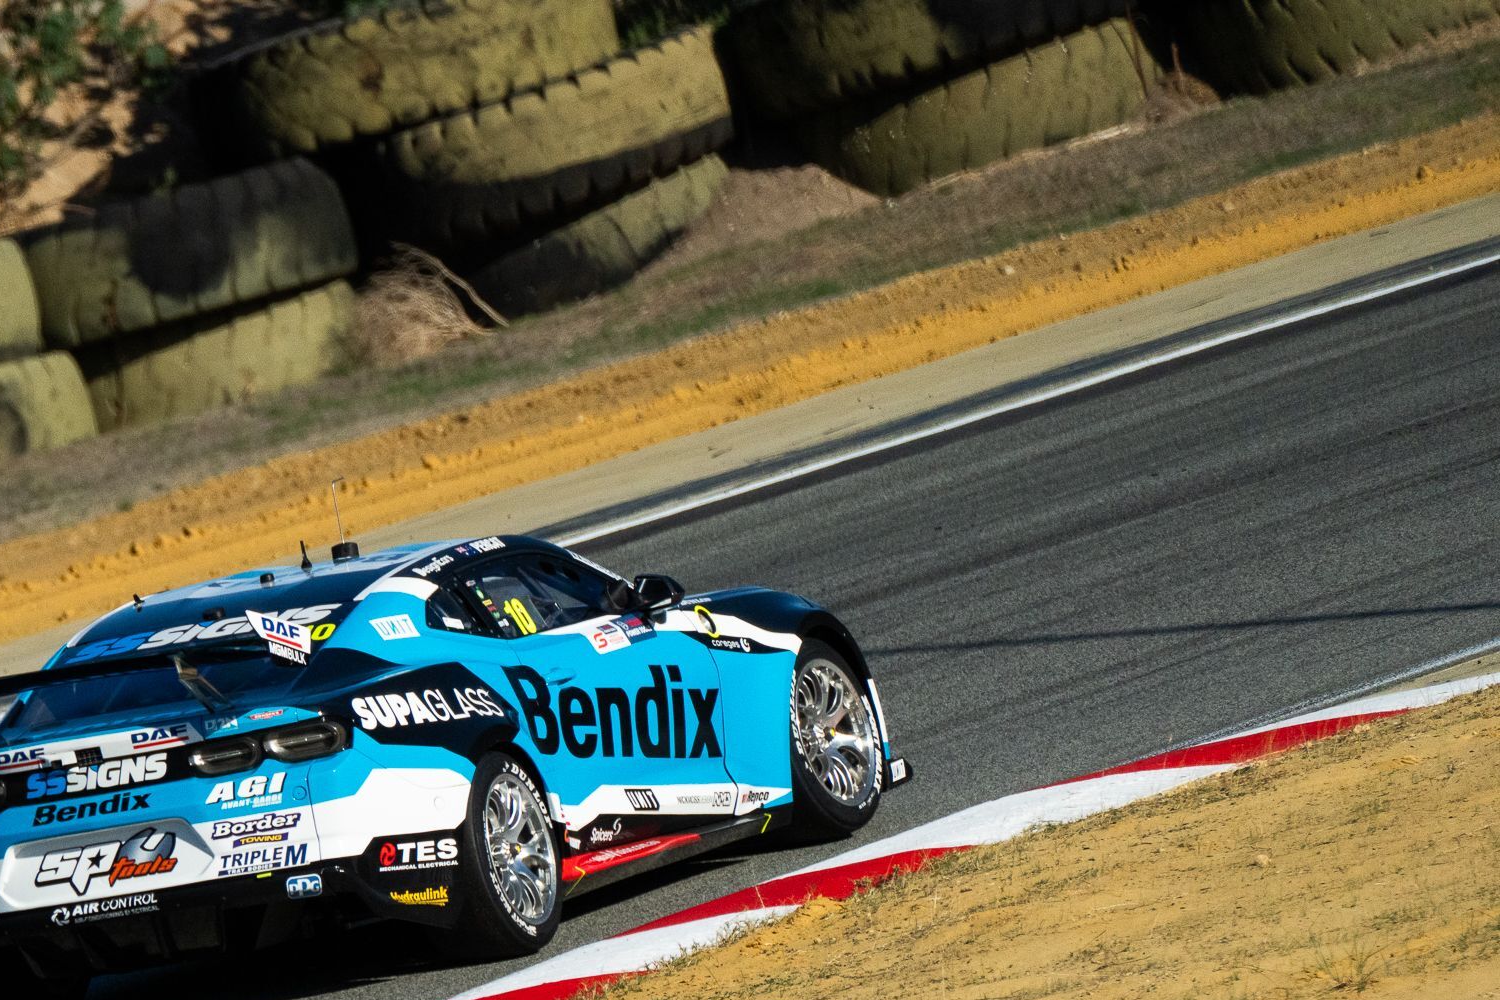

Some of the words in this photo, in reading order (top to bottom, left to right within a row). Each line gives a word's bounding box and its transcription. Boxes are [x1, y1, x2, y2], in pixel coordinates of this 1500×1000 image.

[261, 616, 300, 639] DAF
[503, 597, 537, 636] 10
[307, 623, 336, 641] 0
[351, 687, 504, 731] SUPAGLASS
[500, 664, 724, 759] Bendix
[131, 724, 188, 745] DAF
[205, 771, 286, 805] AGI
[510, 761, 554, 830] DUNLOP
[625, 789, 660, 811] UNIT
[32, 792, 152, 827] Bendix
[212, 813, 300, 839] Border
[239, 835, 282, 845] TOWING
[396, 838, 458, 864] TES
[379, 863, 417, 873] MECHANICAL
[417, 859, 459, 870] ELECTRICAL
[72, 902, 100, 917] AIR
[100, 892, 158, 912] CONTROL
